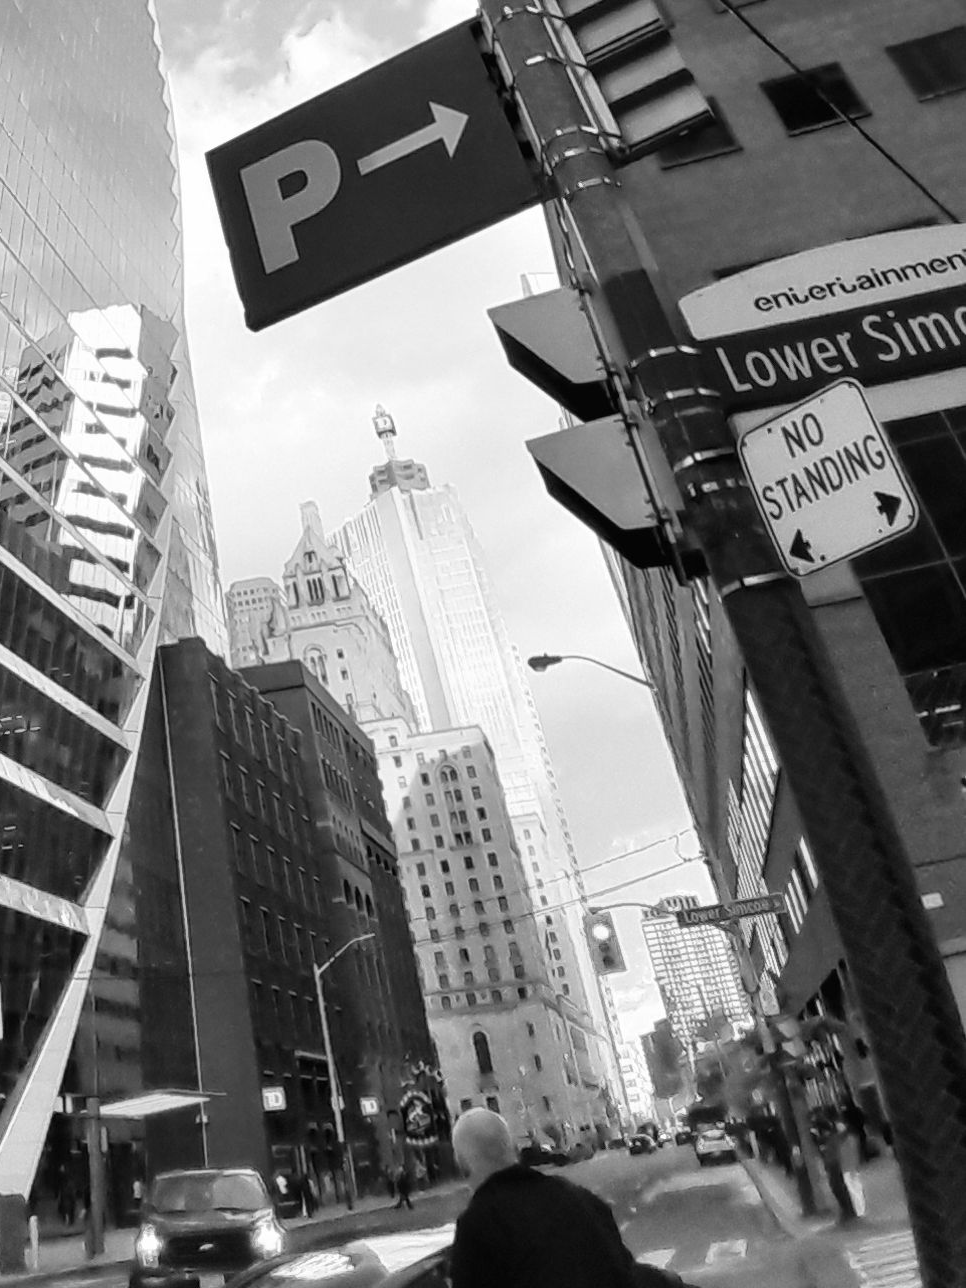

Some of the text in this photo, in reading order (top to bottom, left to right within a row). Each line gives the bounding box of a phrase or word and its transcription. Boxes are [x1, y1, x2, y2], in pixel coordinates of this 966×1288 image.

[239, 140, 342, 275] P
[754, 248, 966, 313] entertainmen
[715, 331, 860, 394] Lower
[780, 412, 825, 459] NO
[761, 435, 887, 521] STANDING
[683, 909, 720, 923] Lower
